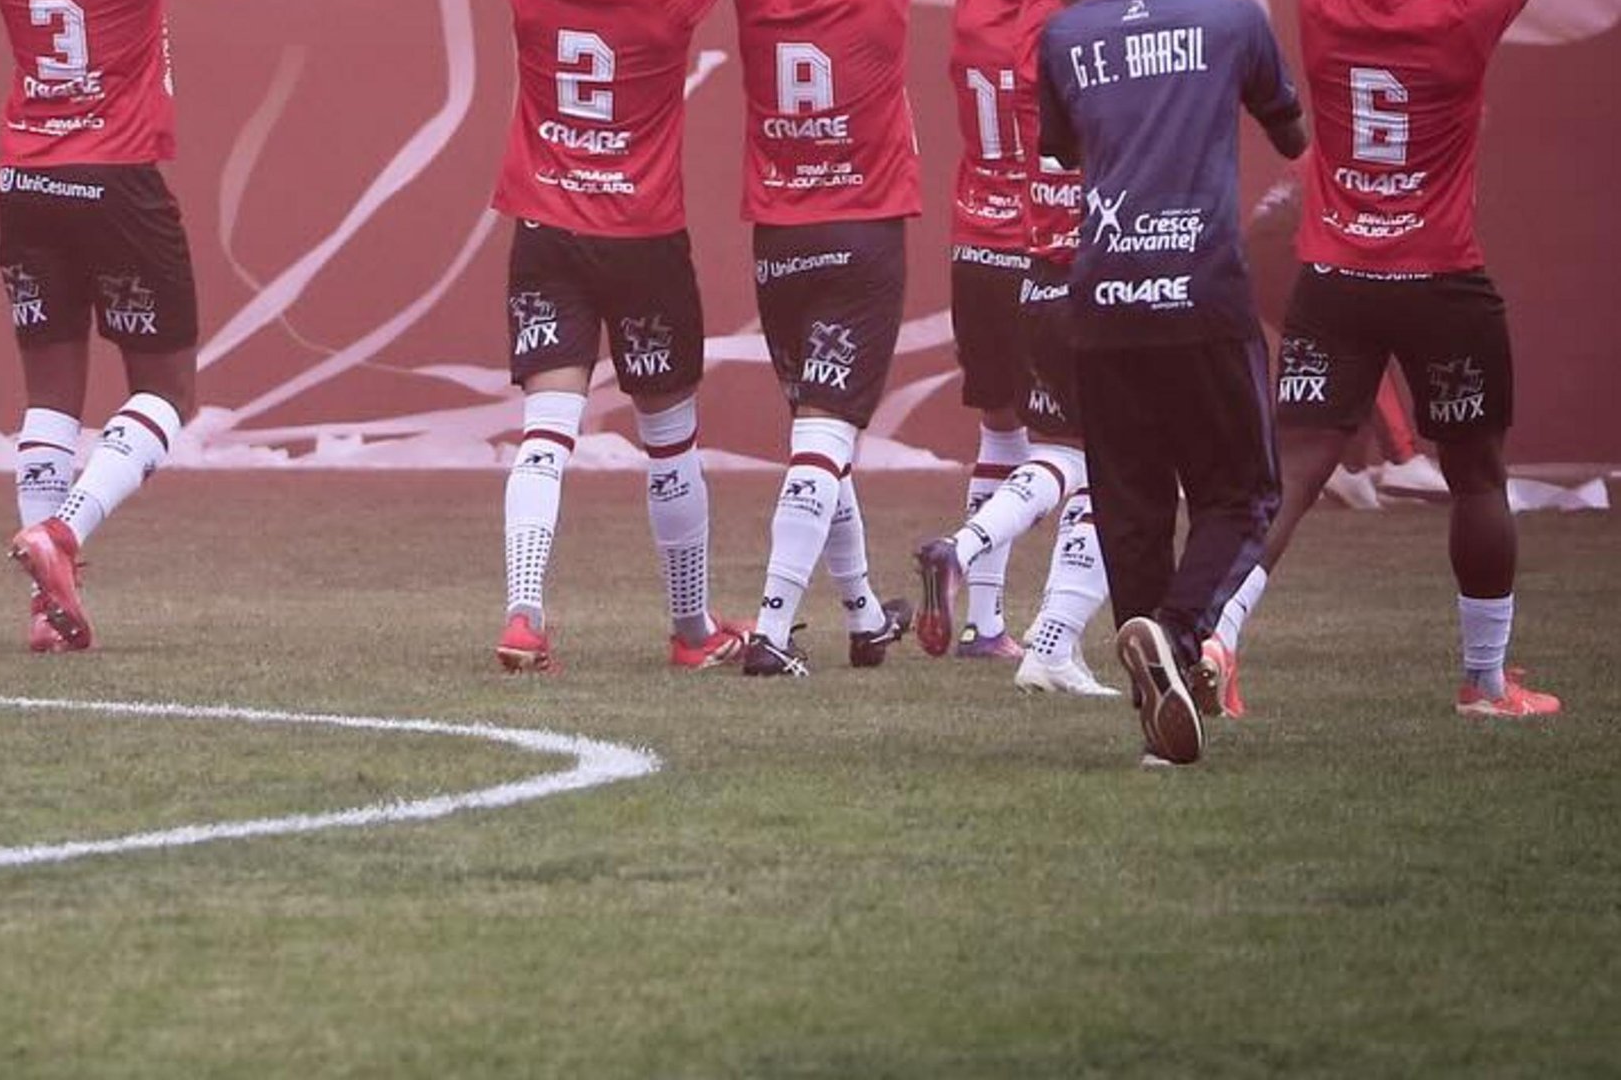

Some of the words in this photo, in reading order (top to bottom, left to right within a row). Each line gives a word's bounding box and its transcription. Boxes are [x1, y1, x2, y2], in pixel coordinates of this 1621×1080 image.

[1071, 40, 1120, 89] G.E.
[1126, 27, 1208, 78] BRASIL
[556, 28, 616, 122] 2
[763, 115, 850, 140] CRIARE
[1349, 67, 1409, 166] 6
[15, 172, 106, 200] UniCesumar
[1135, 212, 1205, 234] Cresce,
[1106, 228, 1197, 253] Xavante!
[1095, 275, 1192, 305] CRIARE
[105, 308, 157, 334] MVX
[624, 350, 672, 377] MVX
[801, 358, 851, 390] MVX
[1430, 393, 1485, 423] MVX
